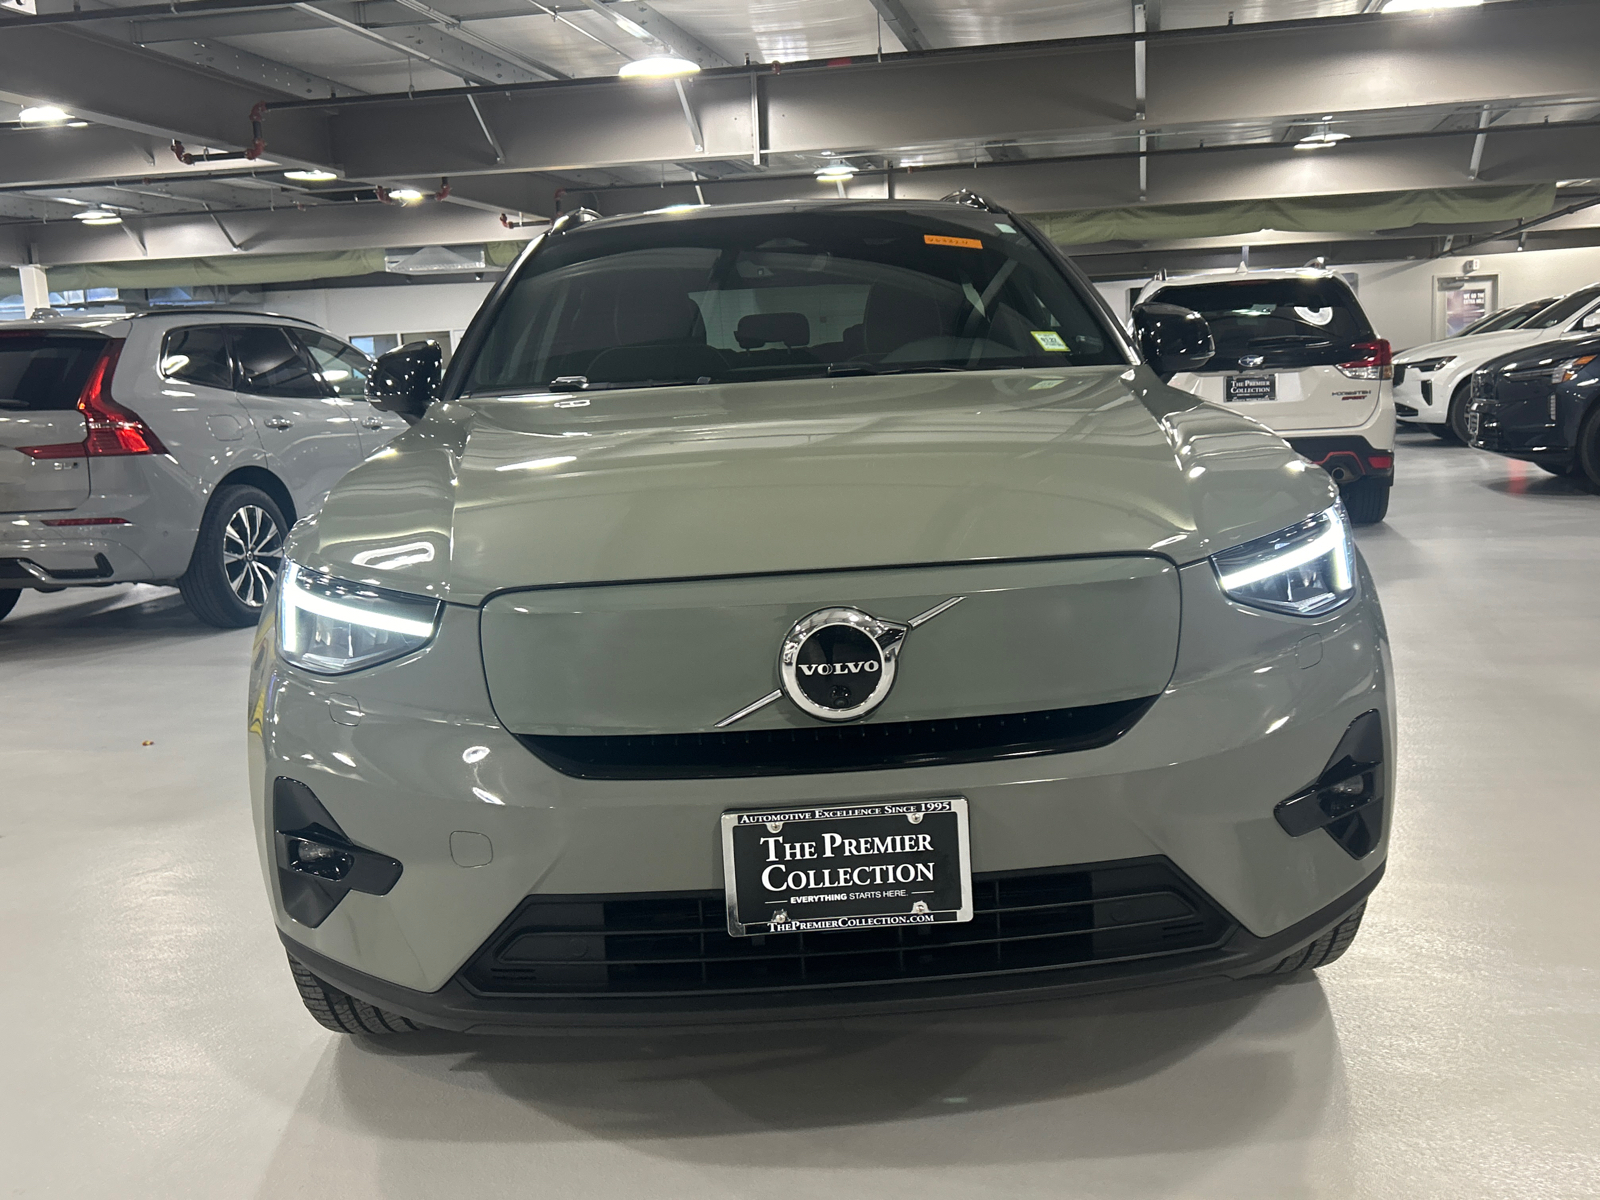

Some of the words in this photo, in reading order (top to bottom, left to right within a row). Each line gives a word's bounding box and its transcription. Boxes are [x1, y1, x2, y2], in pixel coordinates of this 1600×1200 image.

[798, 659, 880, 676] VOLVO
[740, 812, 812, 824] AUTOMOTIVE
[814, 807, 882, 819] EXCELLENCE
[884, 804, 917, 814] SINCE
[920, 801, 950, 812] 1995
[759, 836, 818, 862] THE
[821, 832, 934, 858] PREMIER
[761, 862, 936, 892] COLLECTION
[790, 893, 847, 904] EVERYTHING
[849, 890, 881, 900] STARTS
[882, 889, 909, 898] HERE.
